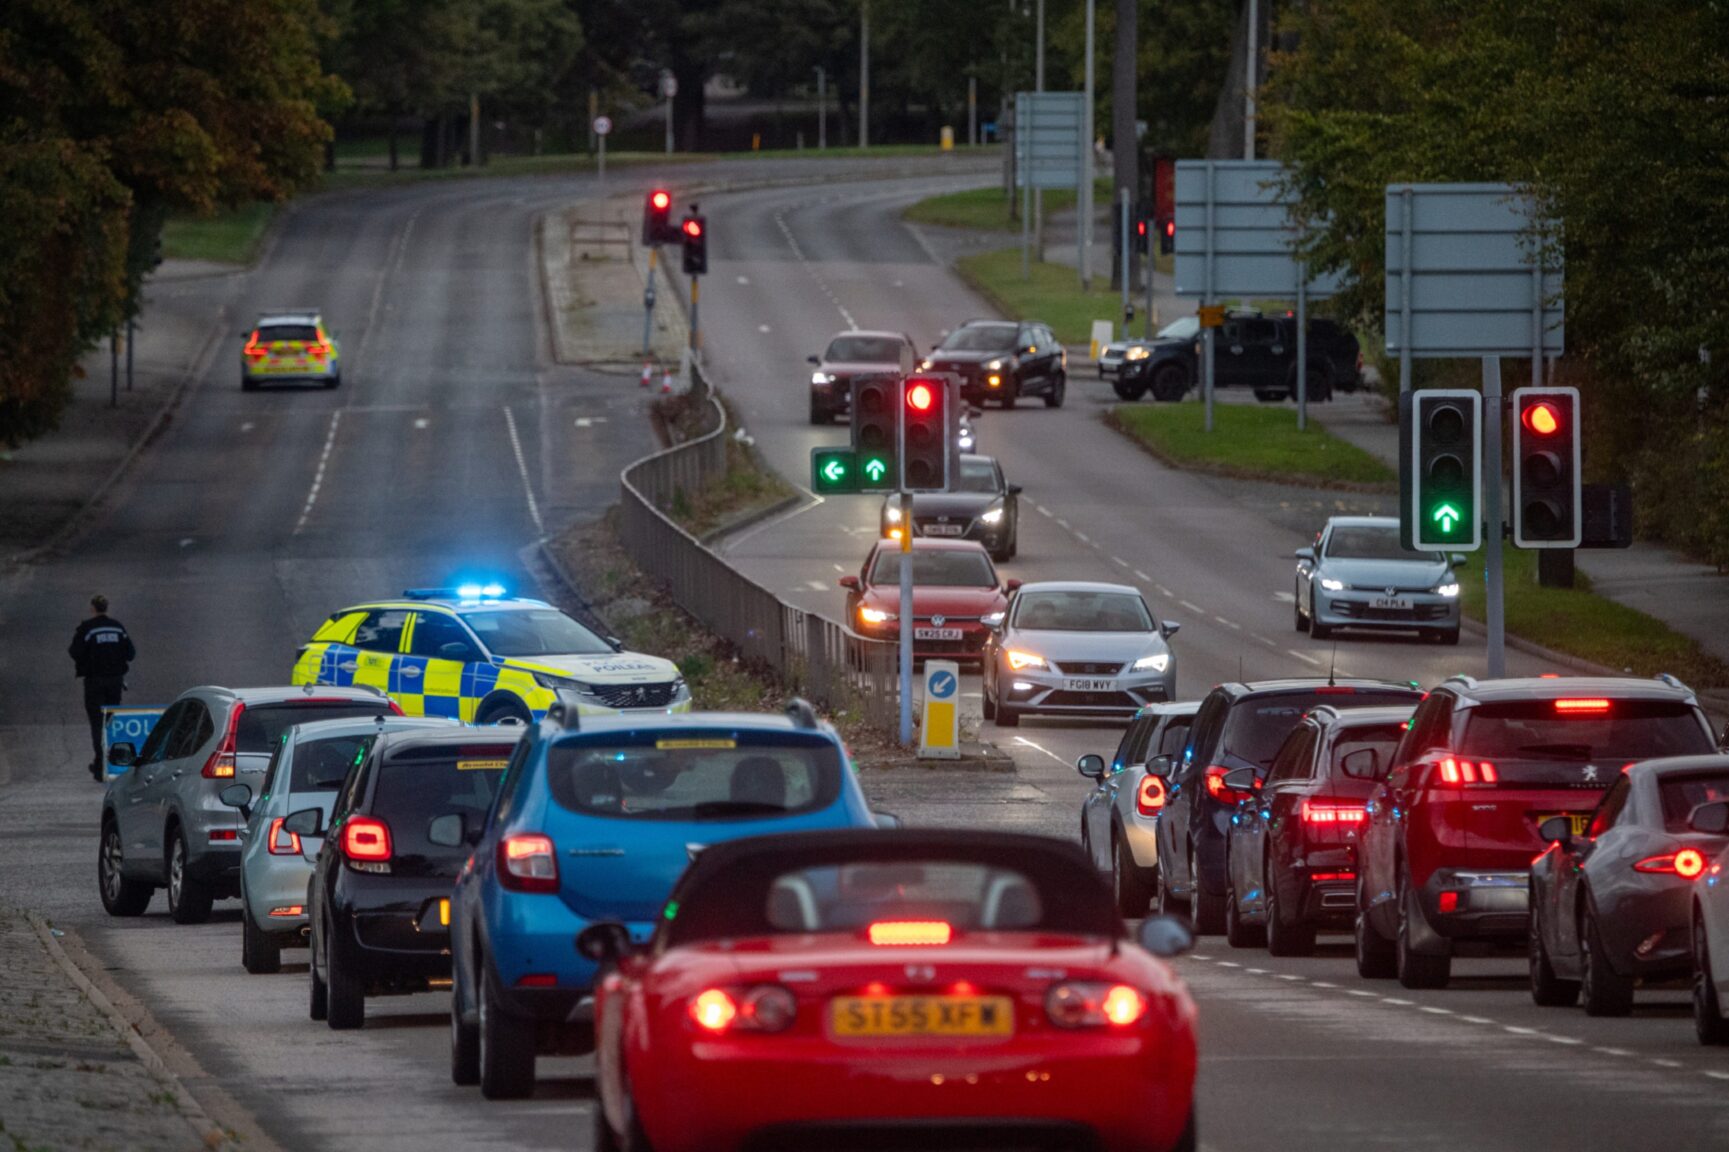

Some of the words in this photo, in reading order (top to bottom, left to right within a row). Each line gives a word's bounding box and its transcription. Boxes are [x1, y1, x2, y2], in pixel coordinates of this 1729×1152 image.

[1069, 681, 1091, 690] FG18
[112, 718, 157, 738] POL
[848, 1001, 928, 1031] ST55
[938, 1002, 997, 1029] XFW
